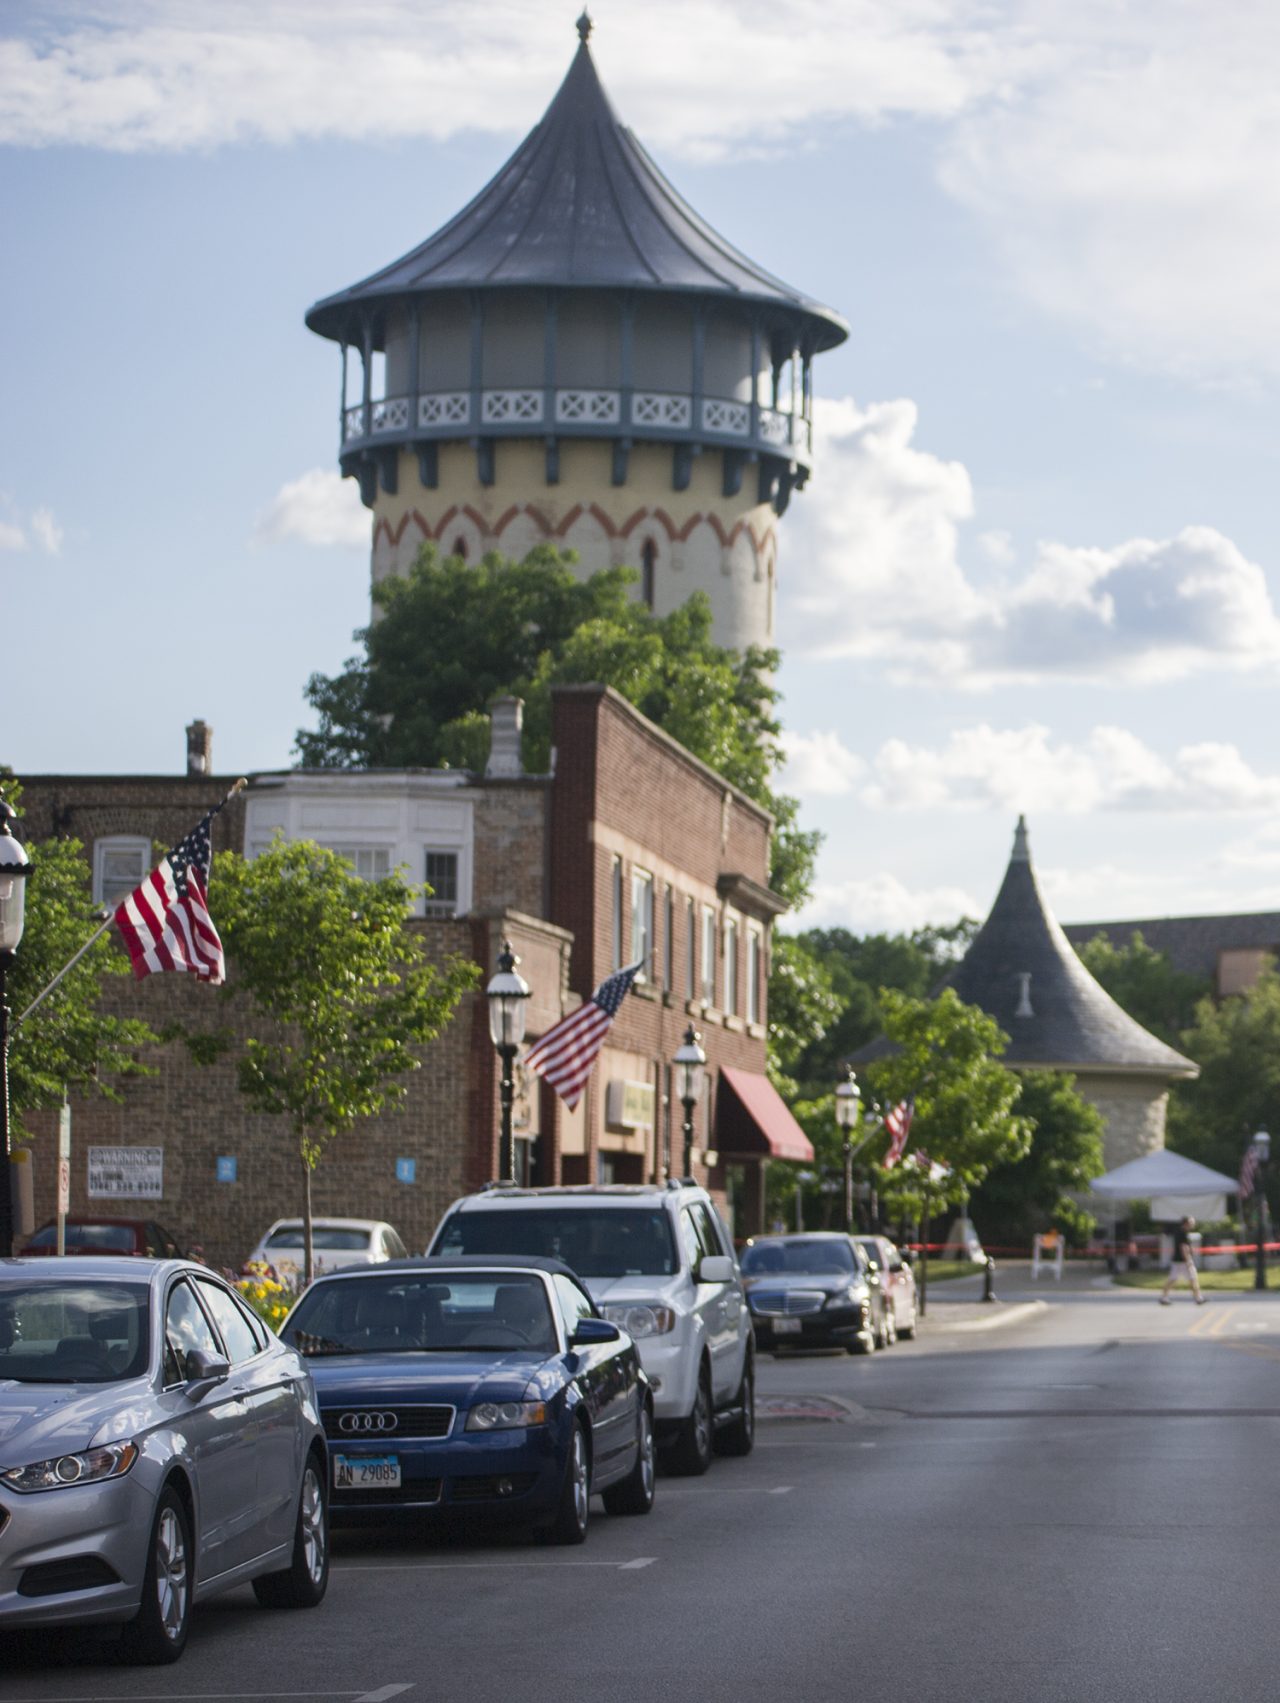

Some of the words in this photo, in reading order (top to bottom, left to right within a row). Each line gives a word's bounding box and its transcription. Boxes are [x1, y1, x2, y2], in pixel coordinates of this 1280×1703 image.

[102, 1151, 148, 1165] WARNING
[339, 1464, 353, 1482] AN
[361, 1463, 398, 1481] 29085
